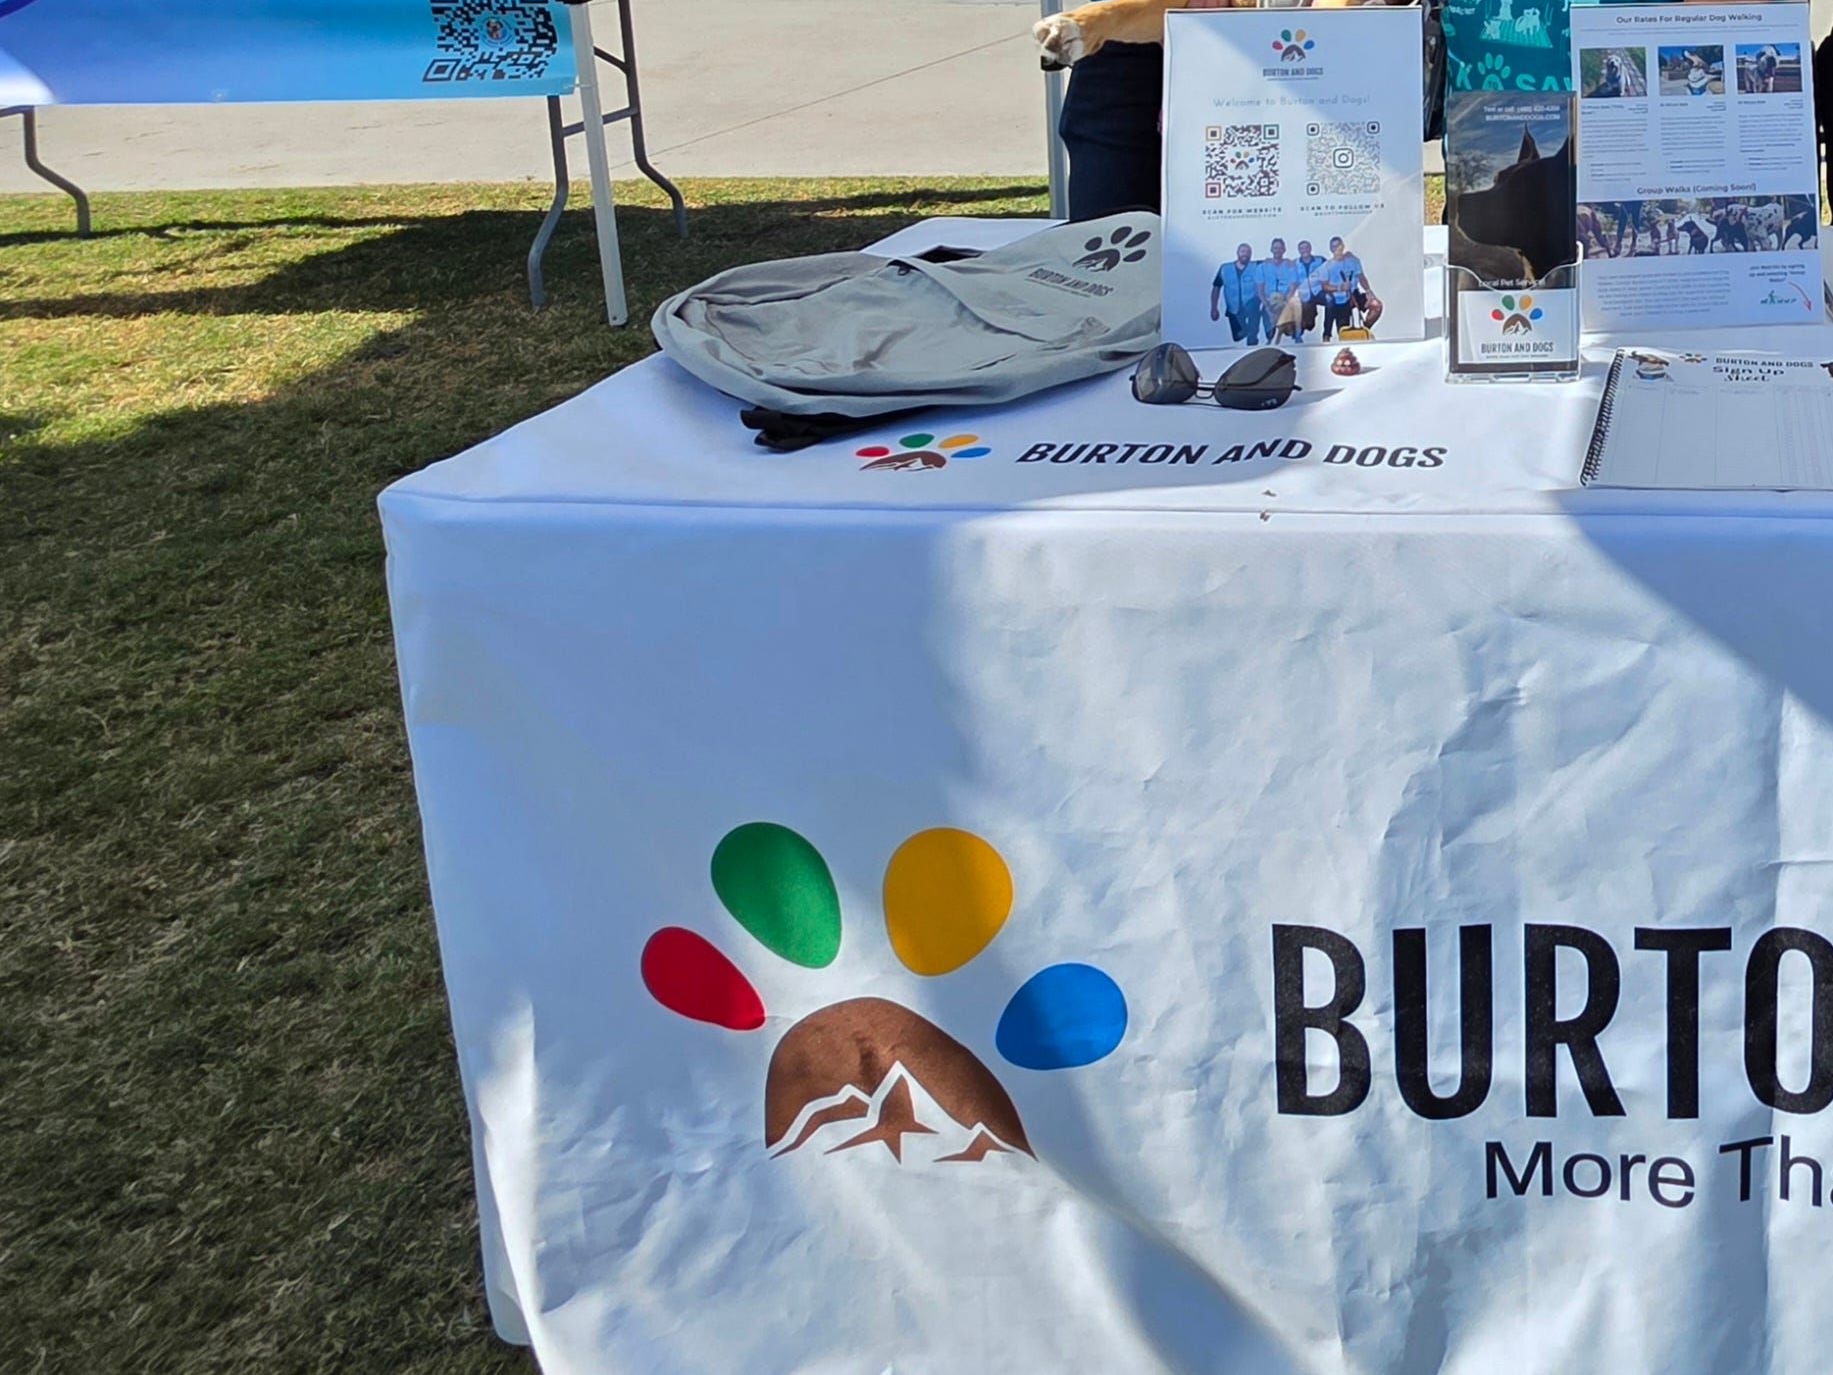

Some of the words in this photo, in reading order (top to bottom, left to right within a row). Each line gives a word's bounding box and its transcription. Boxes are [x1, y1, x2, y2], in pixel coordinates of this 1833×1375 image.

[1616, 15, 1633, 24] Our
[1634, 15, 1657, 24] Rates
[1659, 14, 1673, 23] For
[1675, 14, 1707, 24] Regular
[1708, 13, 1727, 23] Dog
[1728, 12, 1763, 23] Walking
[1213, 98, 1261, 108] Welcome
[1266, 98, 1275, 106] to
[1280, 97, 1315, 106] Burton
[1319, 96, 1339, 106] and
[1342, 95, 1371, 107] Dogs!
[1637, 186, 1663, 197] Group
[1665, 185, 1690, 194] Walks
[1692, 183, 1729, 194] (Coming
[1481, 343, 1512, 353] BURTON
[1514, 343, 1531, 352] AND
[1533, 341, 1554, 353] DOGS
[1716, 357, 1758, 365] BURTON
[1713, 366, 1752, 375] Sign
[1759, 368, 1784, 376] Up
[1015, 441, 1208, 466] BURTON
[1213, 438, 1313, 466] AND
[1323, 443, 1448, 469] DOGS
[1484, 1139, 1696, 1209] More
